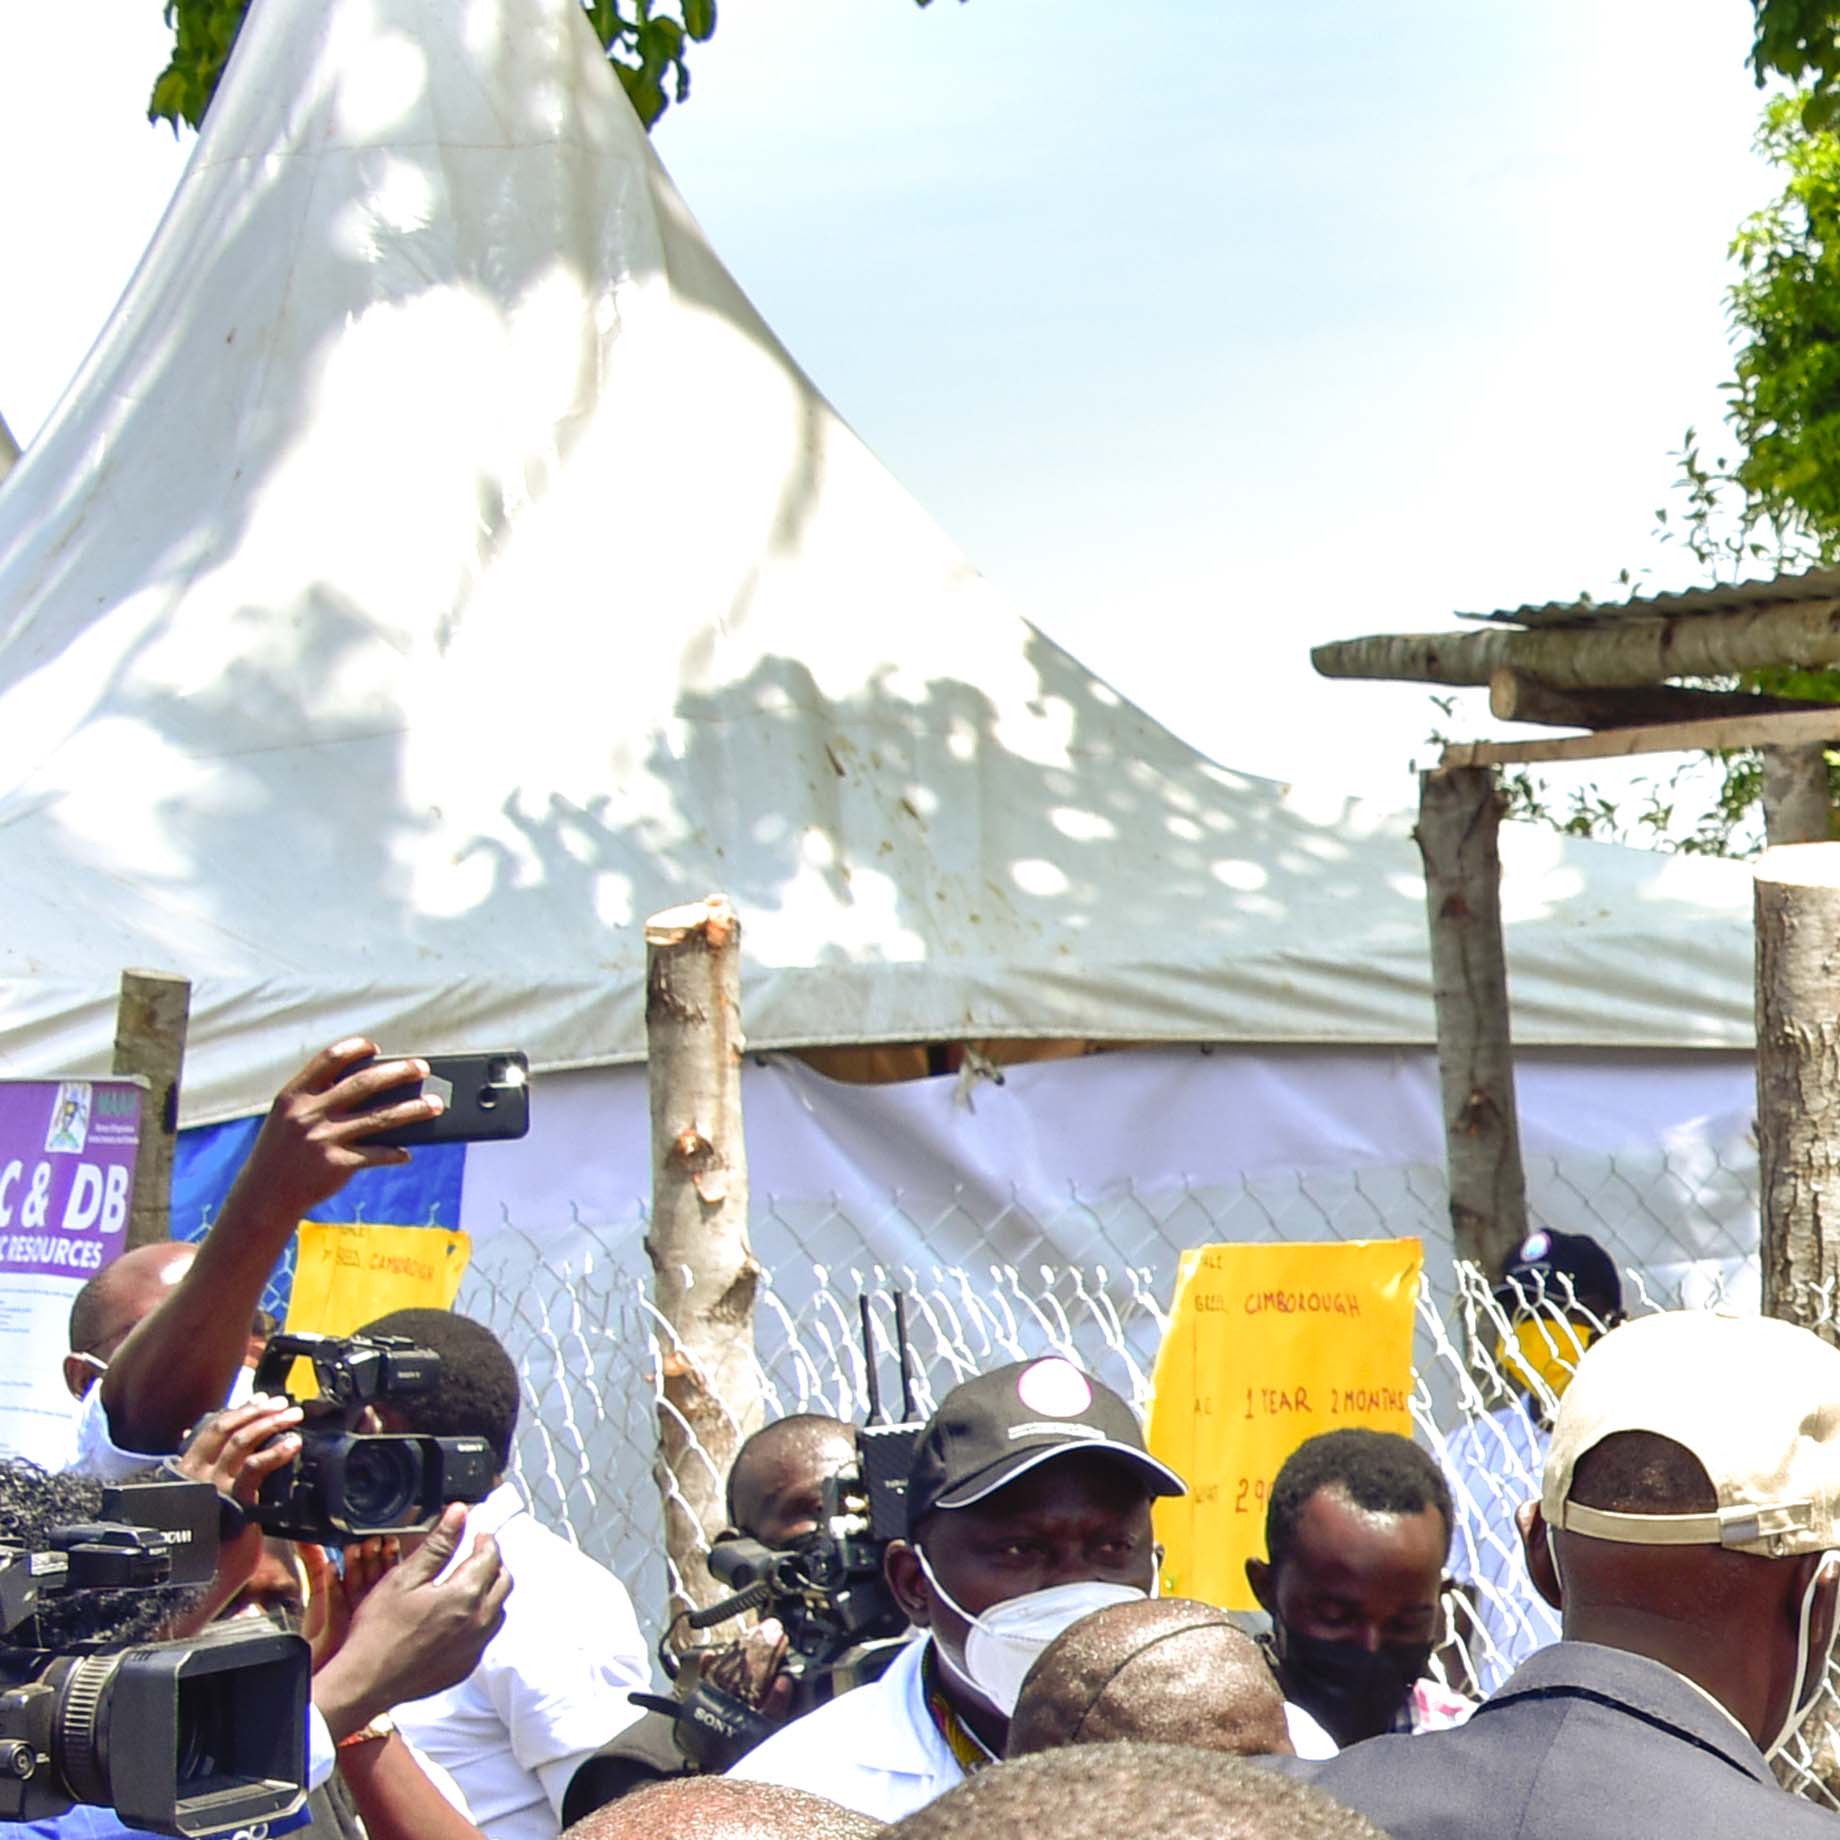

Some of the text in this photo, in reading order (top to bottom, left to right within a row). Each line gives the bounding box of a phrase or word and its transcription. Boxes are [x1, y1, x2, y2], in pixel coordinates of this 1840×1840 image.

[21, 1161, 51, 1229] &
[62, 1163, 129, 1234] DB
[8, 1235, 103, 1270] RESOURCES
[1261, 1386, 1313, 1416] YEAR
